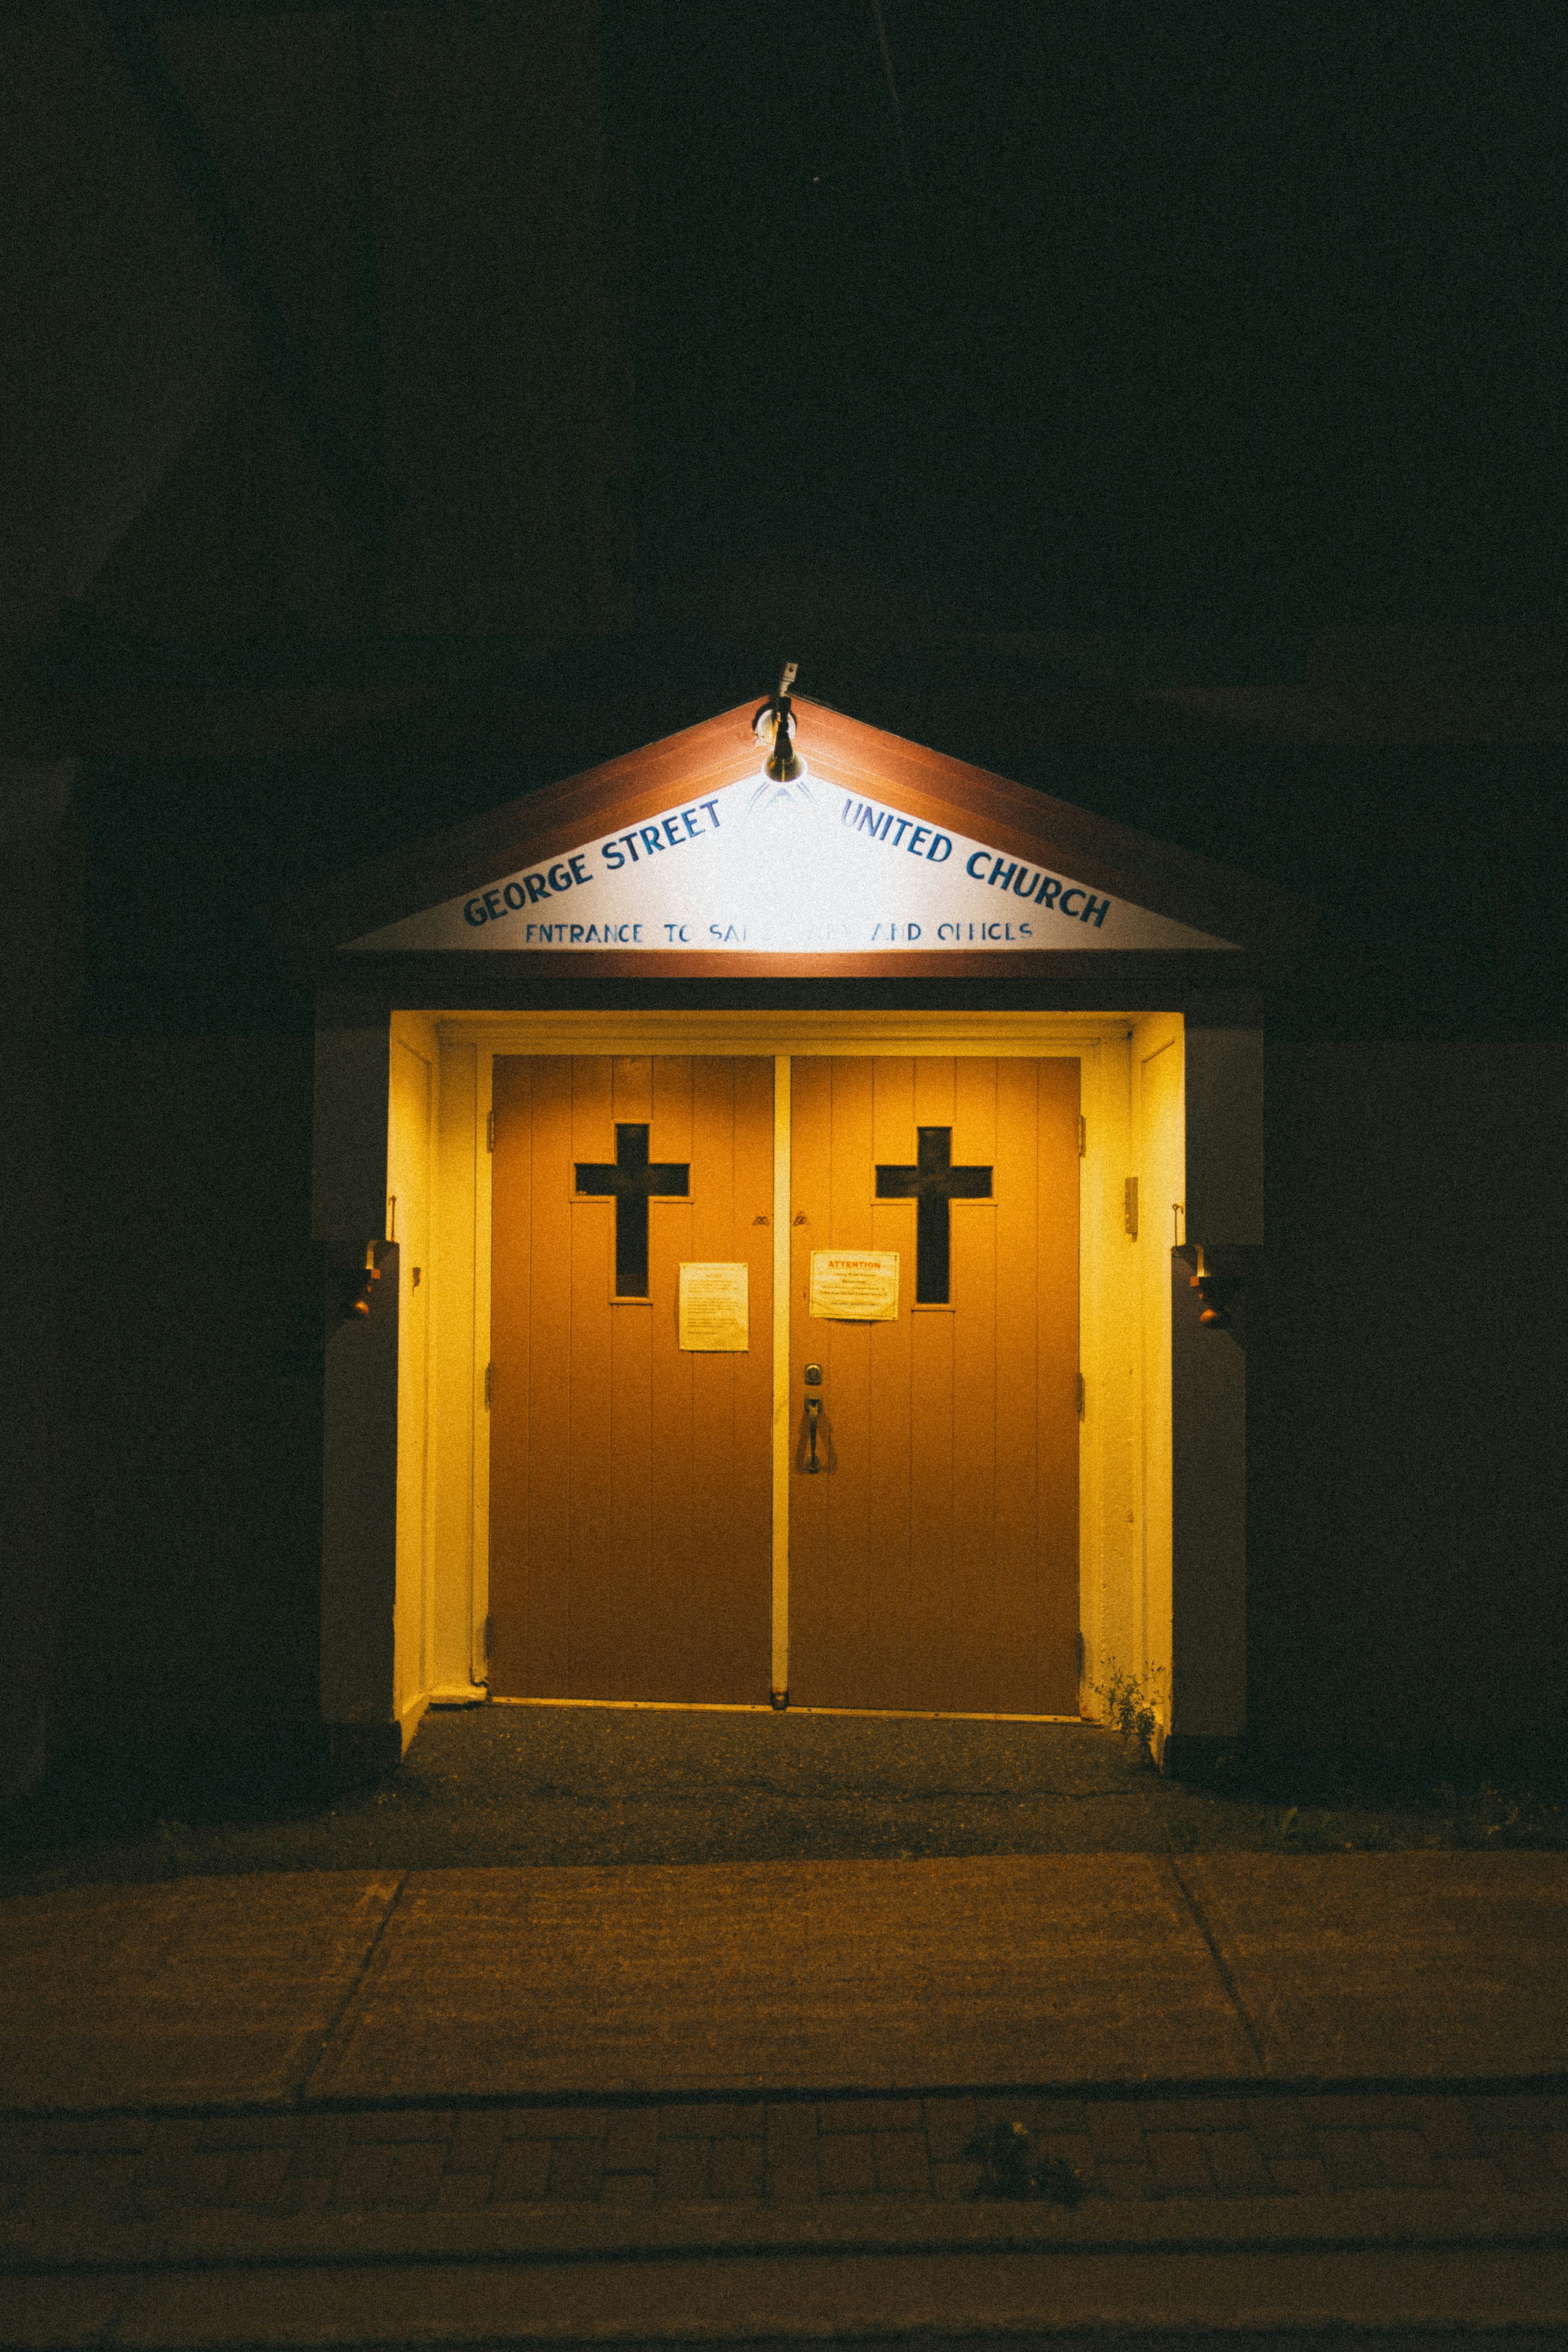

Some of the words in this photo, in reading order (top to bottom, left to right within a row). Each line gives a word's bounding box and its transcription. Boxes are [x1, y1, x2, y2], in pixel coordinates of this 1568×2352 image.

[463, 853, 594, 927] GEORGE
[602, 798, 720, 870] STREET
[841, 798, 952, 863] UNITED
[966, 851, 1112, 928] CHURCH
[525, 924, 643, 943] ENTRANCE
[664, 924, 693, 942] TO
[828, 1260, 880, 1268] ATTENTION
